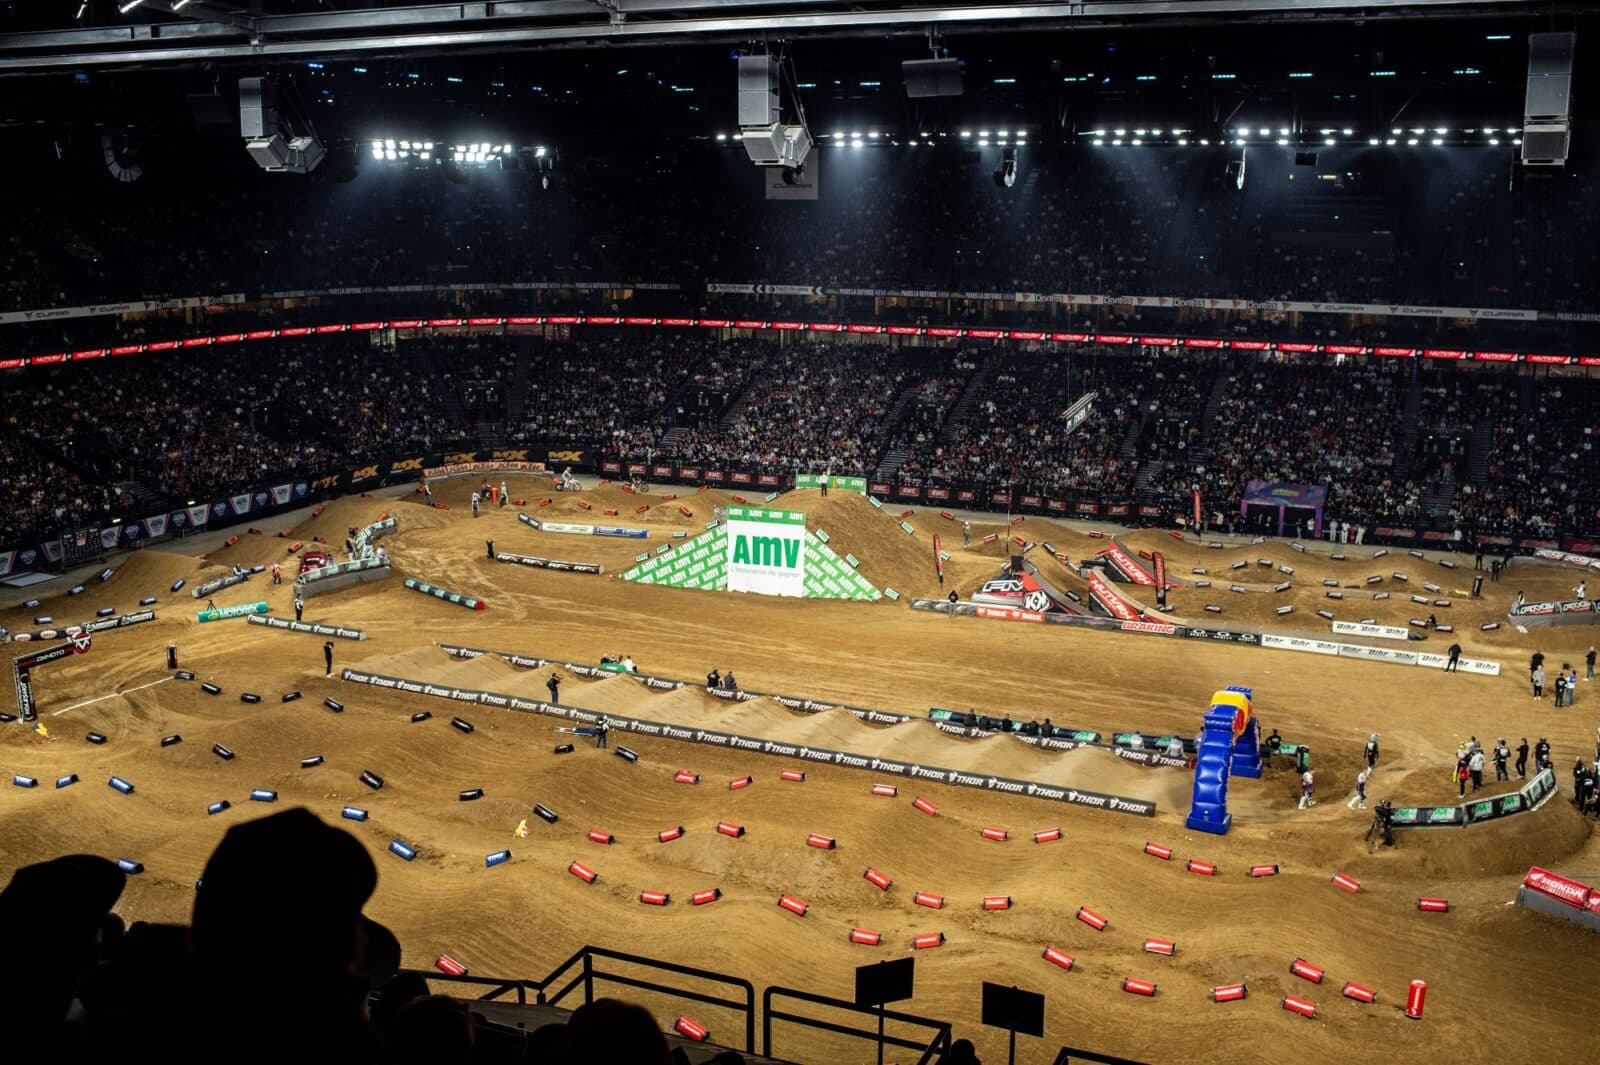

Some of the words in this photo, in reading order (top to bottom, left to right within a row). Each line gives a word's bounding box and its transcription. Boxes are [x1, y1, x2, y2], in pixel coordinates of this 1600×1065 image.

[732, 534, 800, 569] Amv
[1122, 620, 1174, 634] BRAKING
[518, 658, 536, 667] THOR
[570, 665, 590, 674] THOR
[654, 680, 674, 688] THOR
[712, 688, 734, 698] THOR
[780, 698, 801, 708] THOR
[875, 713, 898, 724] THOR
[941, 723, 966, 735] THOR
[1048, 740, 1074, 750] THOR
[1122, 750, 1148, 761] THOR
[1159, 756, 1187, 768] THOR
[517, 700, 538, 710] THOR
[546, 705, 567, 716] THOR
[576, 710, 598, 722] THOR
[606, 718, 628, 728] THOR
[637, 723, 660, 734] THOR
[670, 728, 693, 739] THOR
[703, 733, 728, 744] THOR
[737, 739, 761, 750] THOR
[772, 746, 796, 756] THOR
[807, 750, 832, 761] THOR
[843, 756, 868, 767] THOR
[879, 762, 905, 774] THOR
[918, 768, 945, 780] THOR
[957, 775, 984, 786] THOR
[996, 782, 1024, 793] THOR
[1036, 788, 1064, 800] THOR
[1077, 795, 1106, 806] THOR
[1118, 802, 1149, 814] THOR
[1541, 877, 1584, 898] HONDA
